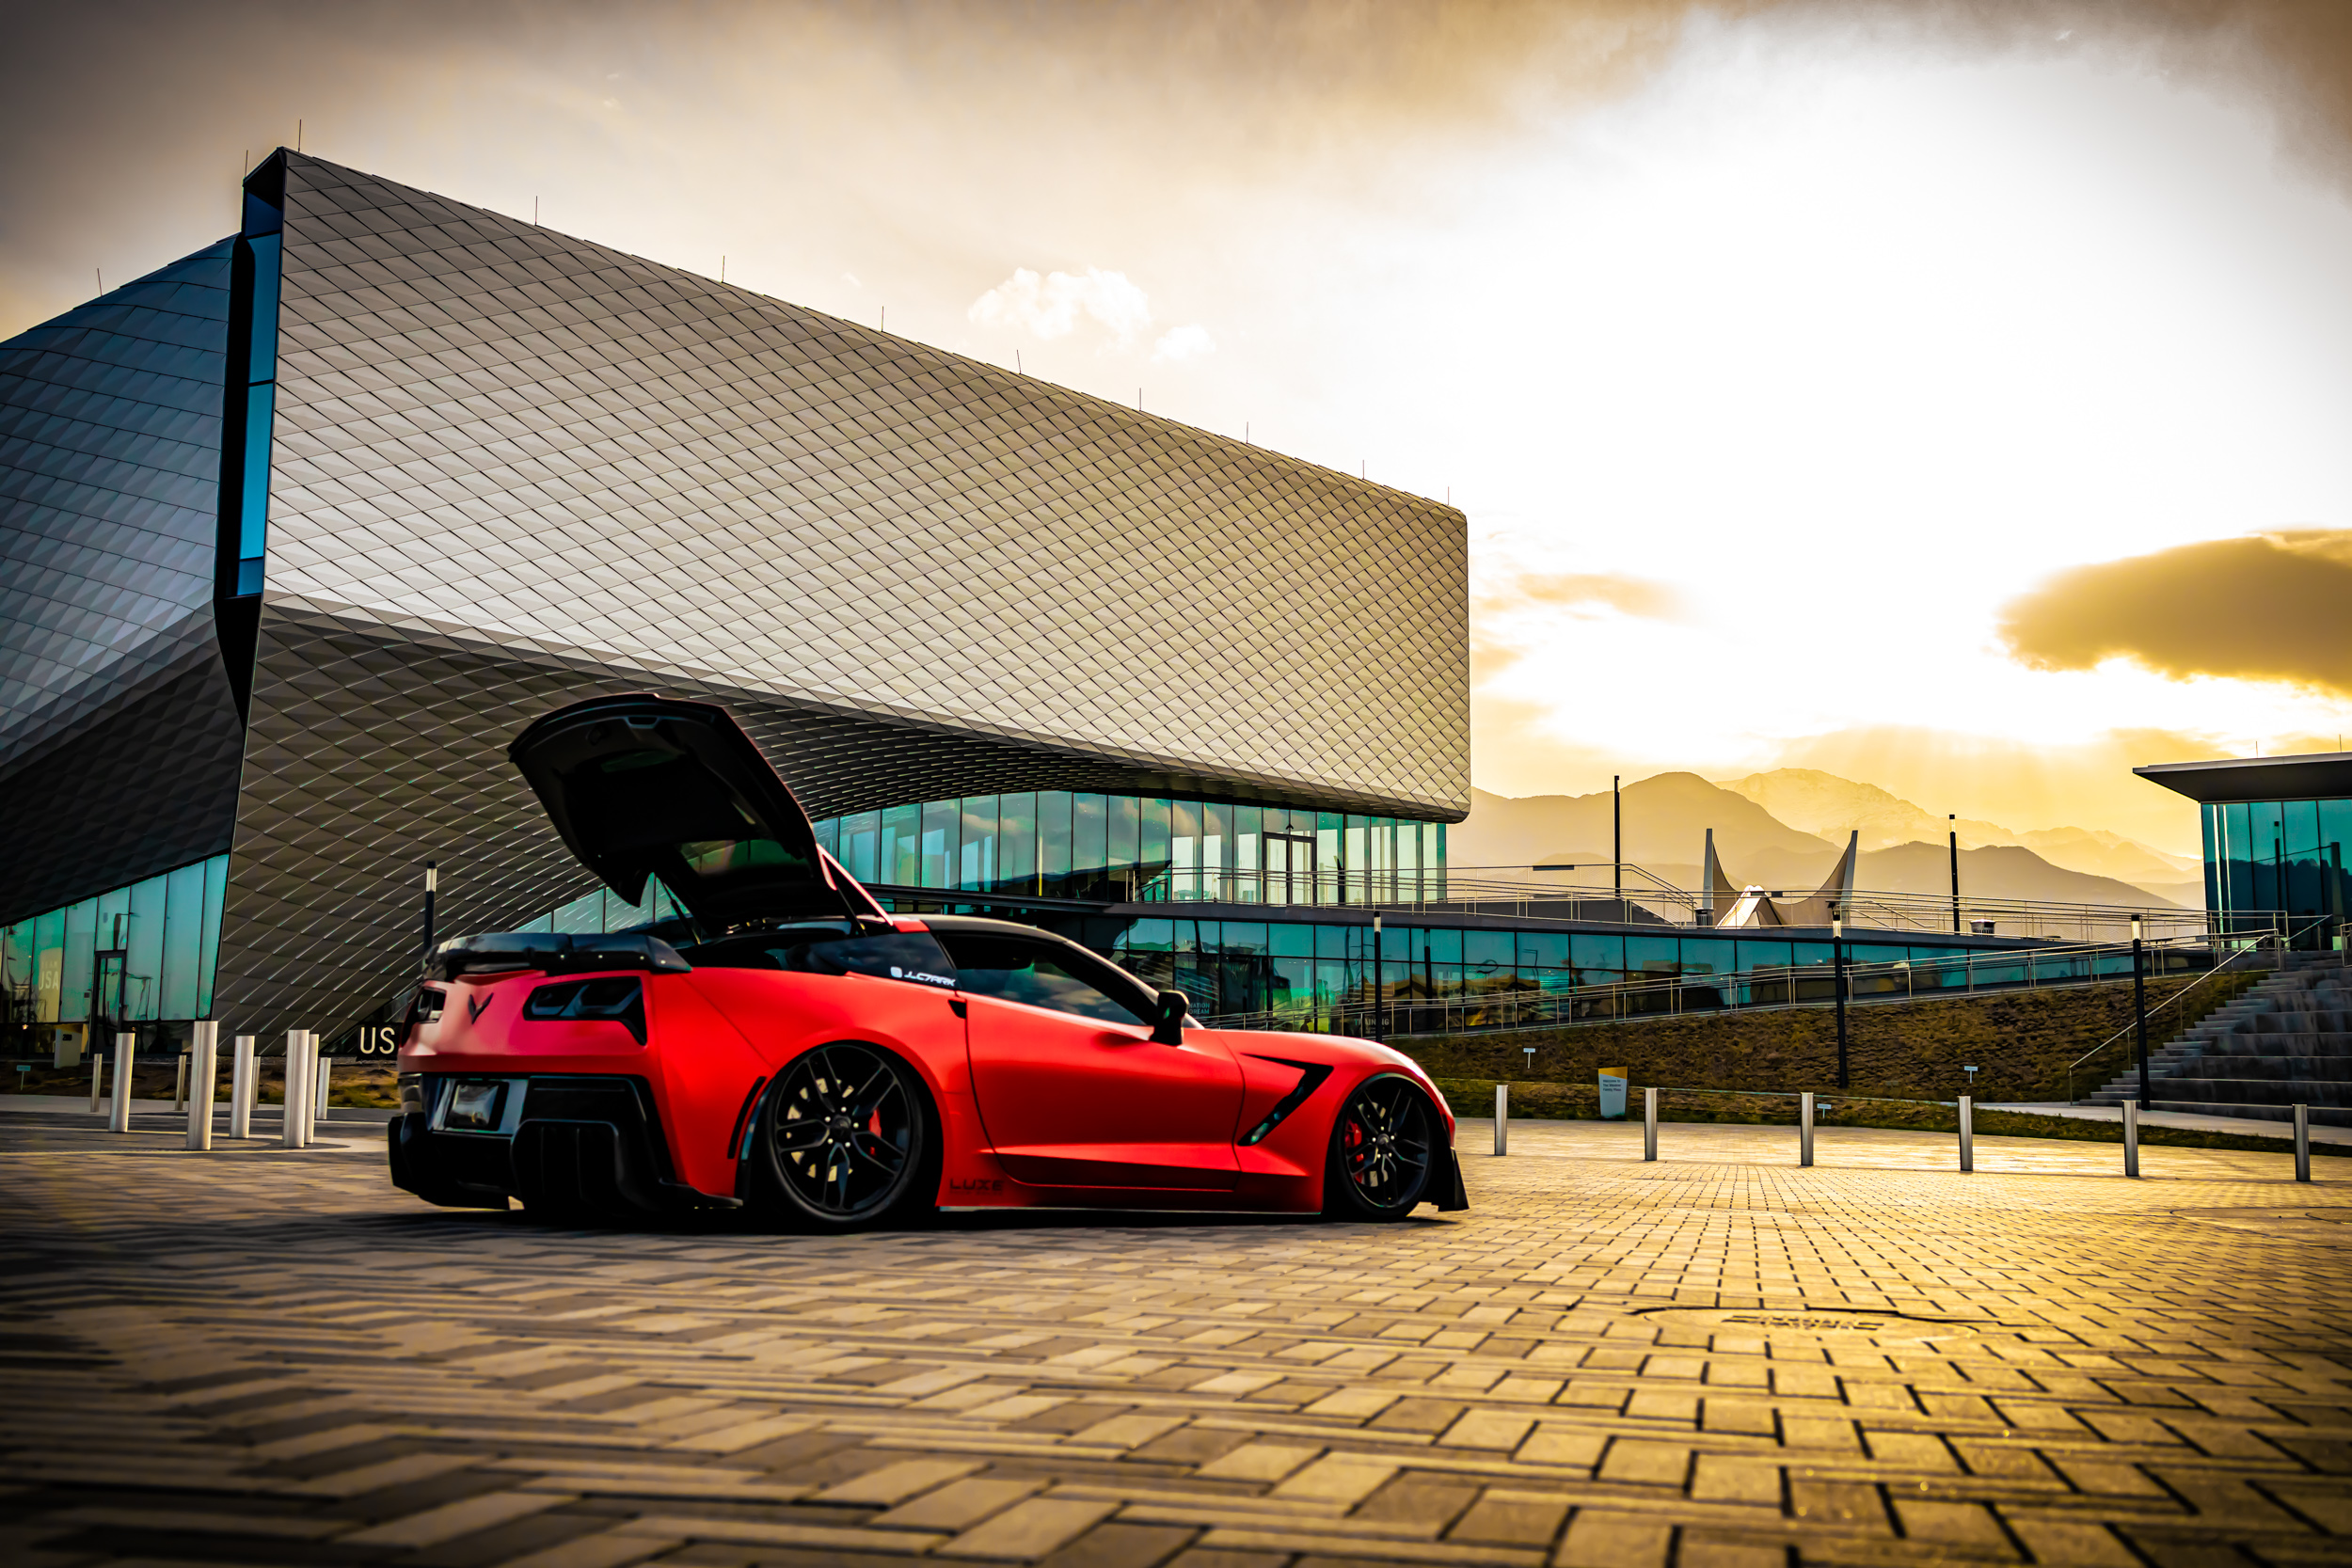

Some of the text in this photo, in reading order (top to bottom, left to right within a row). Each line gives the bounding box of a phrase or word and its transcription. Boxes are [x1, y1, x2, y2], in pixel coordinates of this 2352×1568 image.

[39, 970, 59, 990] USA
[359, 1026, 395, 1054] US
[949, 1179, 1004, 1191] LUXE
